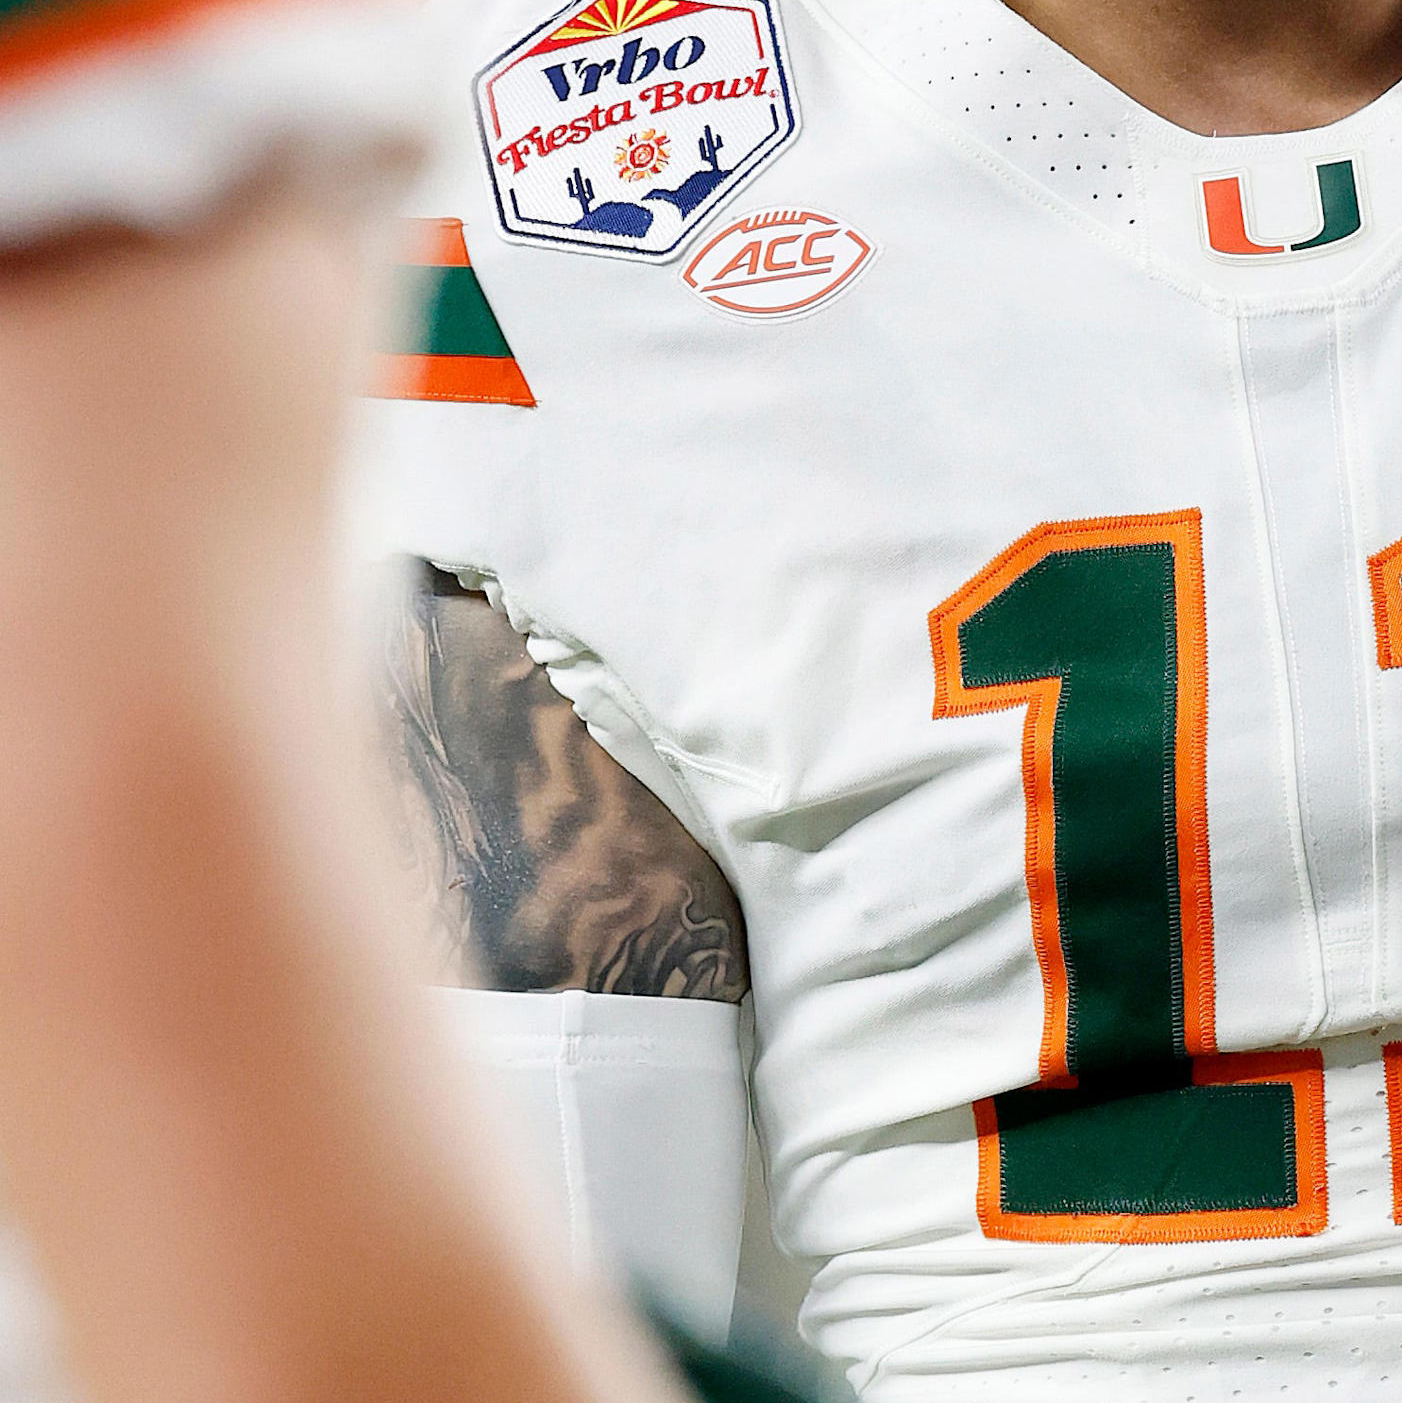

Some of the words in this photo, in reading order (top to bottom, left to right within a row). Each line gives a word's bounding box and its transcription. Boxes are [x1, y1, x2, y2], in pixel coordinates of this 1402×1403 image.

[541, 35, 706, 103] Vrbo
[498, 98, 637, 175] Fiesta
[641, 67, 770, 116] Bowl
[1202, 159, 1362, 255] U
[713, 228, 841, 281] ACC
